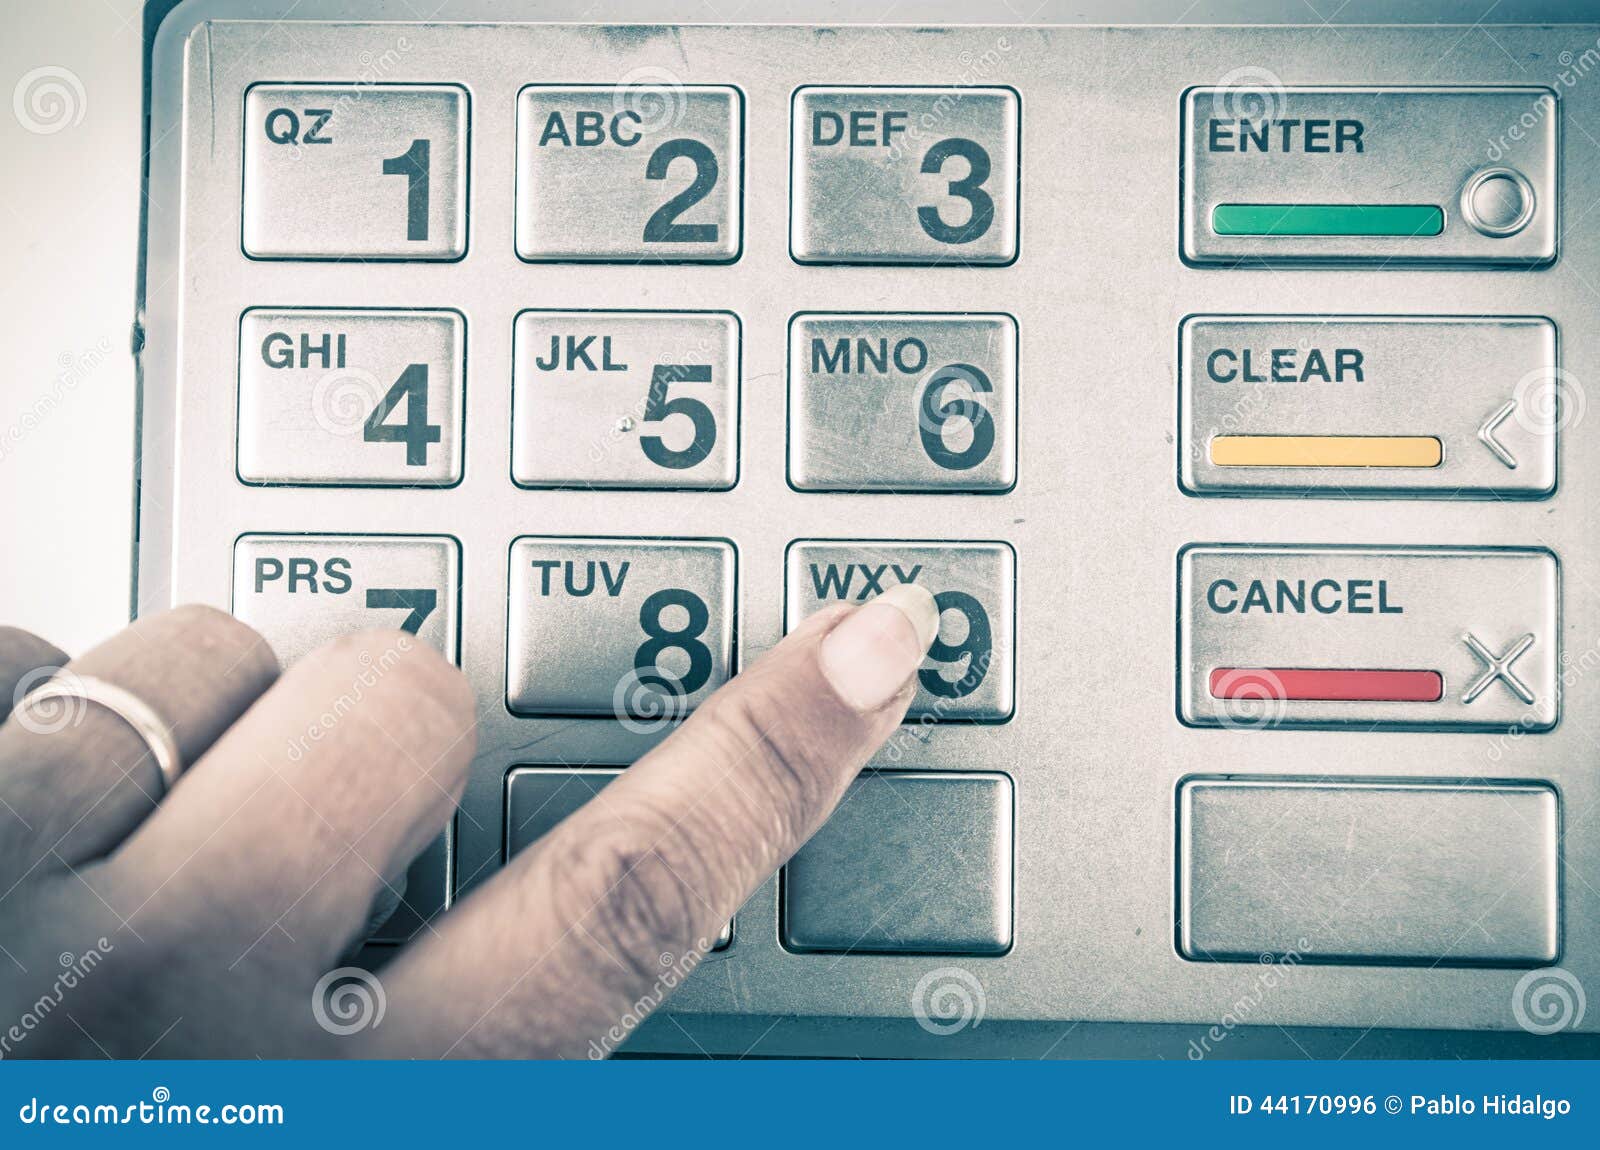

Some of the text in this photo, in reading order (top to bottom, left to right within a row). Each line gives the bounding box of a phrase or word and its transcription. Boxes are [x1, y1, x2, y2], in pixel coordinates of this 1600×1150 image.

[265, 108, 332, 145] QZ
[539, 110, 642, 147] ABC
[813, 110, 908, 147] DEF
[1209, 119, 1364, 153] ENTER
[383, 139, 430, 241] 1
[643, 139, 718, 242] 2
[917, 138, 994, 244] 3
[262, 332, 346, 369] GHI
[536, 336, 627, 371] JKL
[812, 337, 928, 374] MNO
[1207, 349, 1364, 383] CLEAR
[364, 364, 441, 466] 4
[640, 365, 716, 469] 5
[919, 363, 995, 470] 6
[255, 557, 352, 594] PRS
[532, 561, 630, 597] TUV
[1207, 579, 1403, 614] CANCEL
[634, 589, 712, 696] 8
[917, 591, 992, 699] 9
